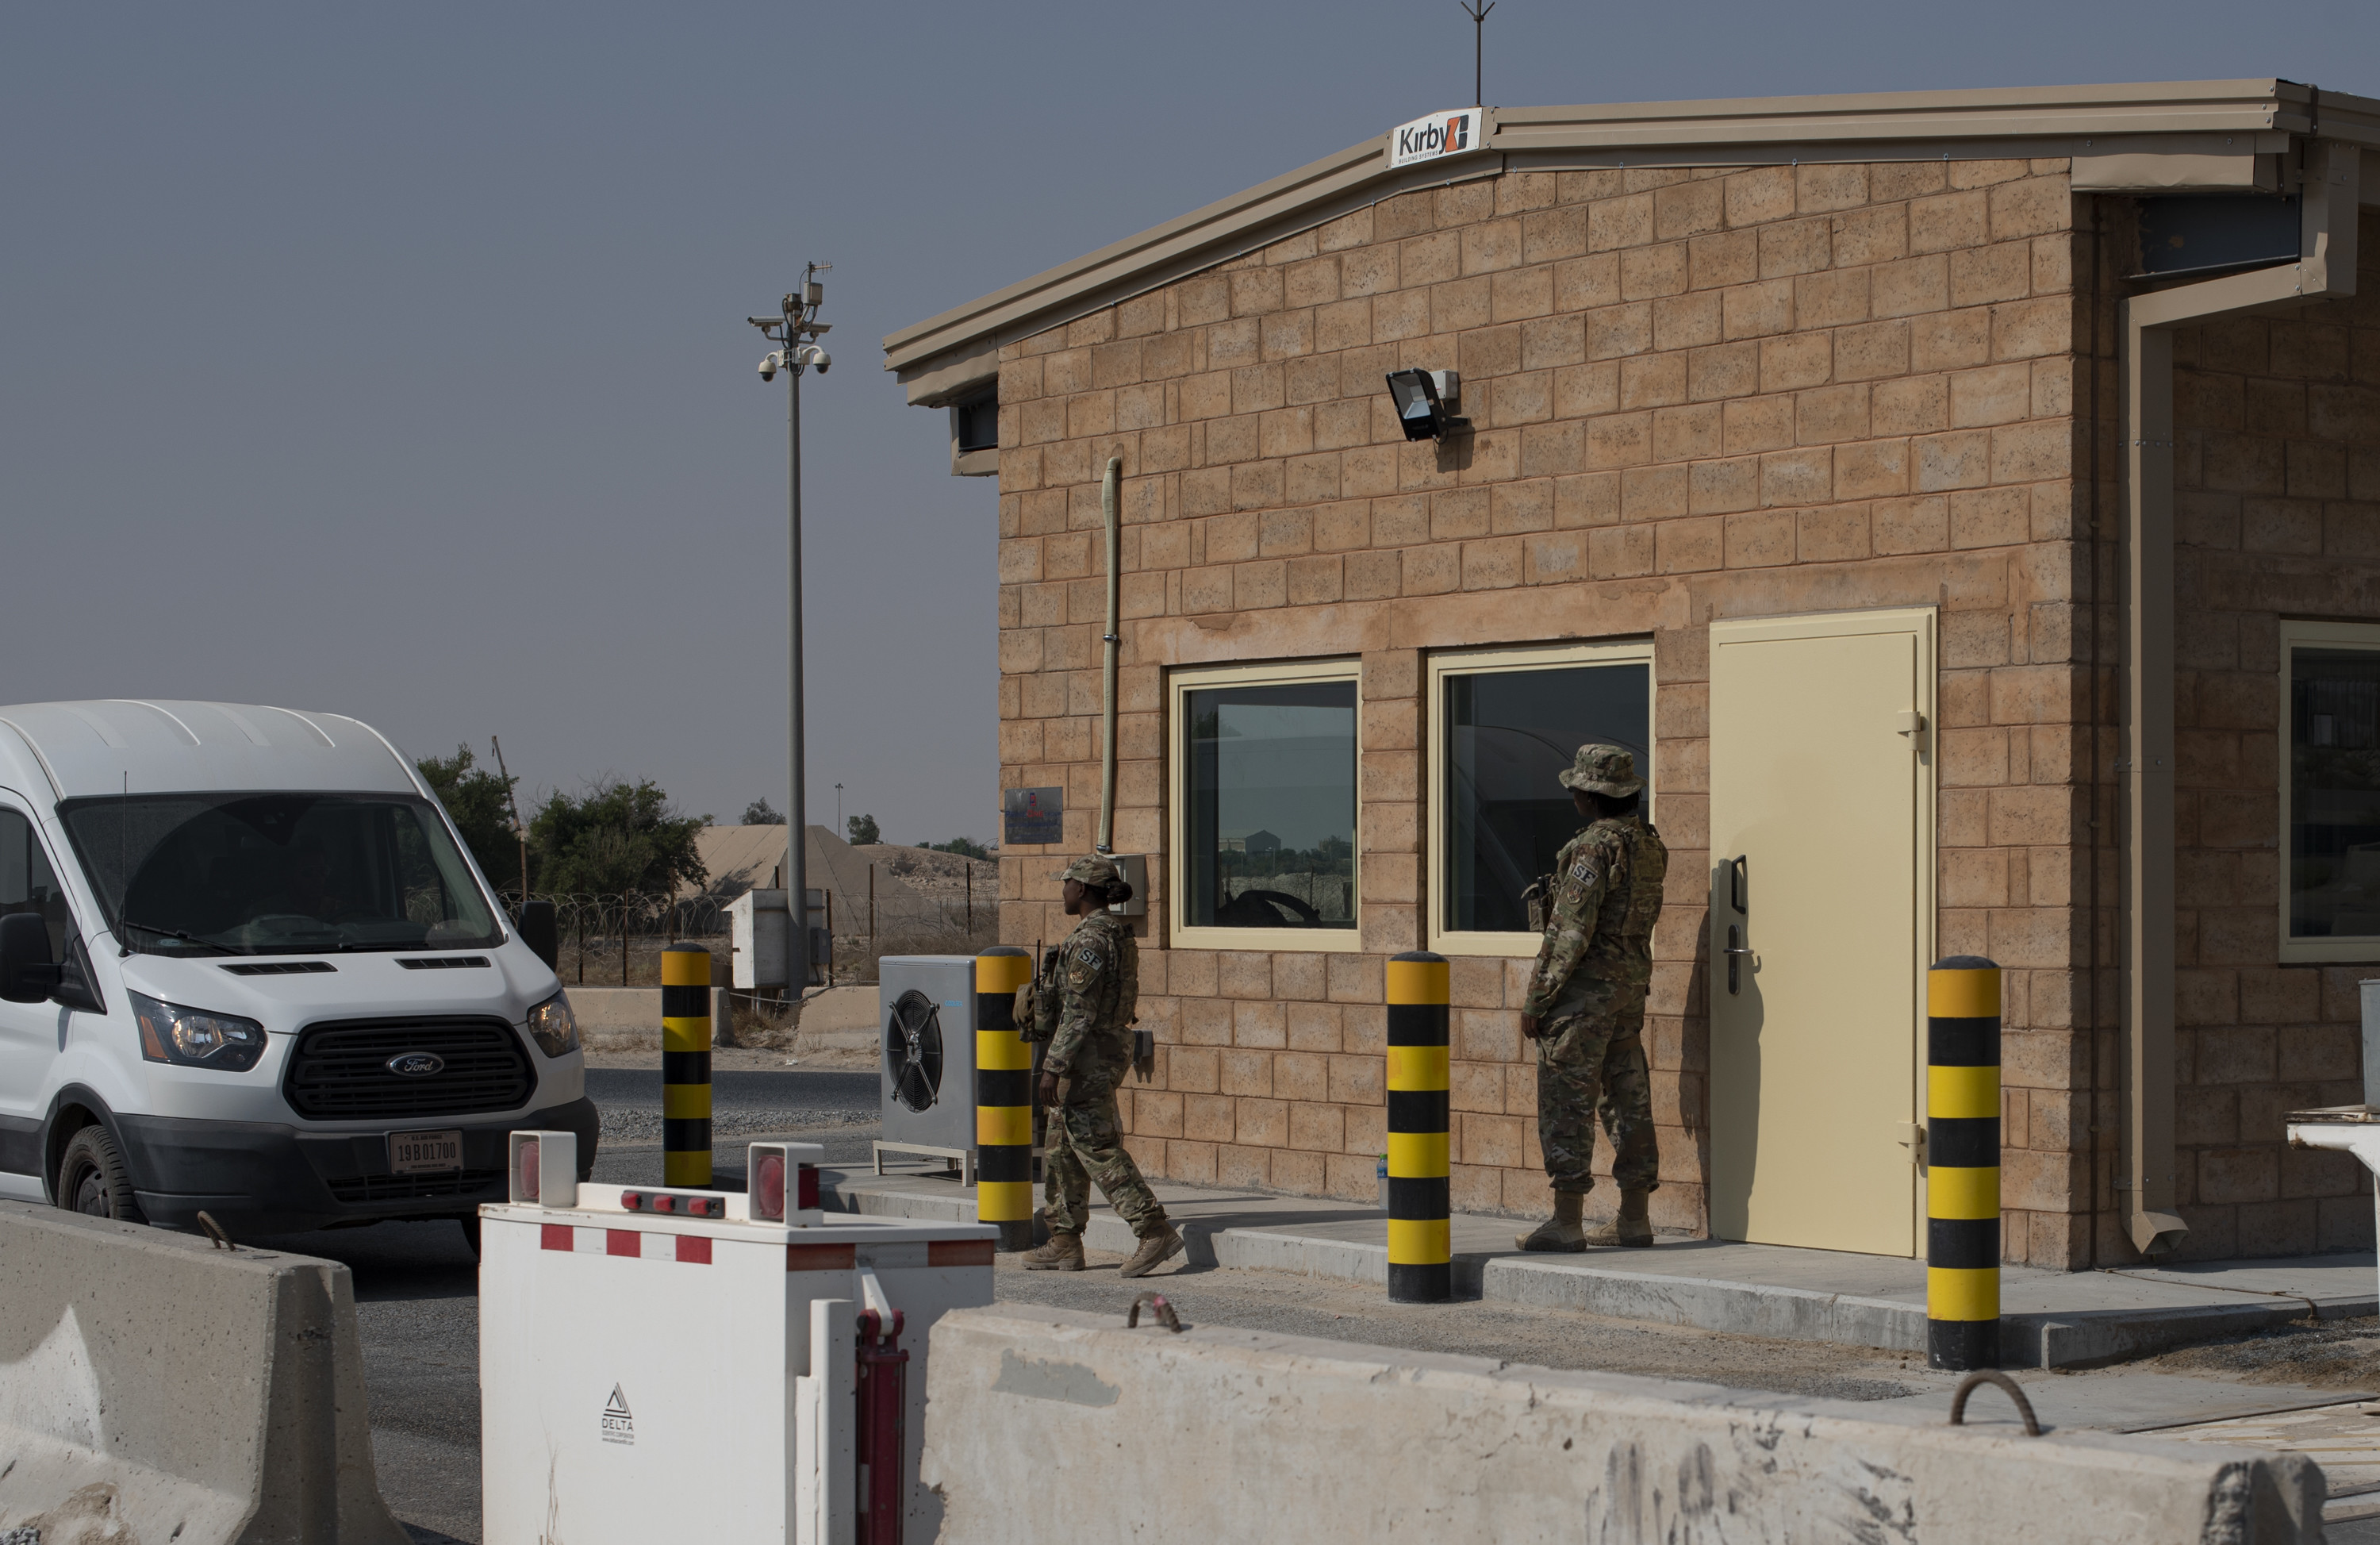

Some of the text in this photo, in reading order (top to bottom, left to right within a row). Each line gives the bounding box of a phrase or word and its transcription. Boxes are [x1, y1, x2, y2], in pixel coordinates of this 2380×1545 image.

[1399, 123, 1450, 156] Kirby
[1399, 150, 1438, 164] BUILDING SYSTEMS
[1573, 865, 1596, 882] SF
[1080, 949, 1102, 967] SF
[404, 1058, 433, 1072] Ford
[601, 1418, 634, 1432] DELTA
